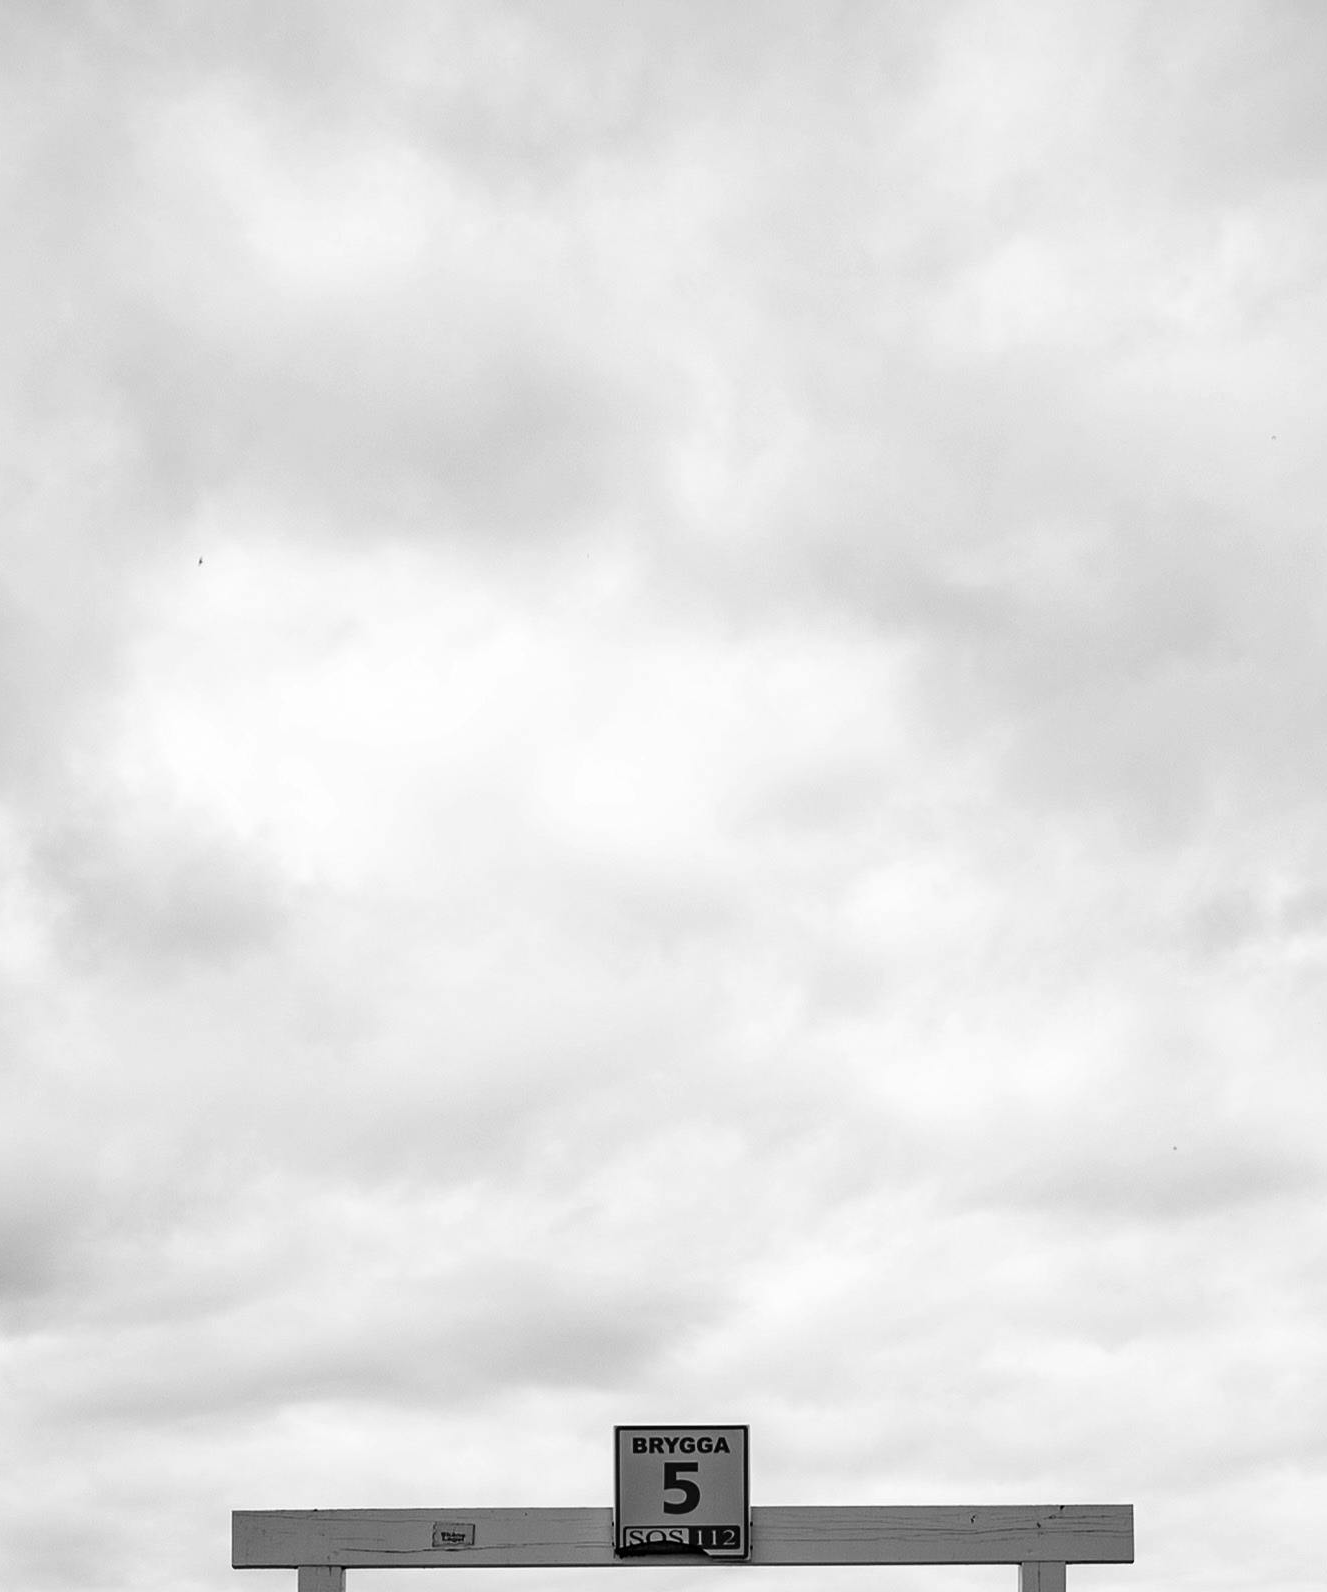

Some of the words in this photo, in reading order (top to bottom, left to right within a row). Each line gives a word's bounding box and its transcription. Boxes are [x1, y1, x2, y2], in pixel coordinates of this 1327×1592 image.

[632, 1437, 730, 1454] BRYGGA
[663, 1462, 701, 1515] 5
[629, 1530, 684, 1545] SOS
[697, 1529, 736, 1545] 112
